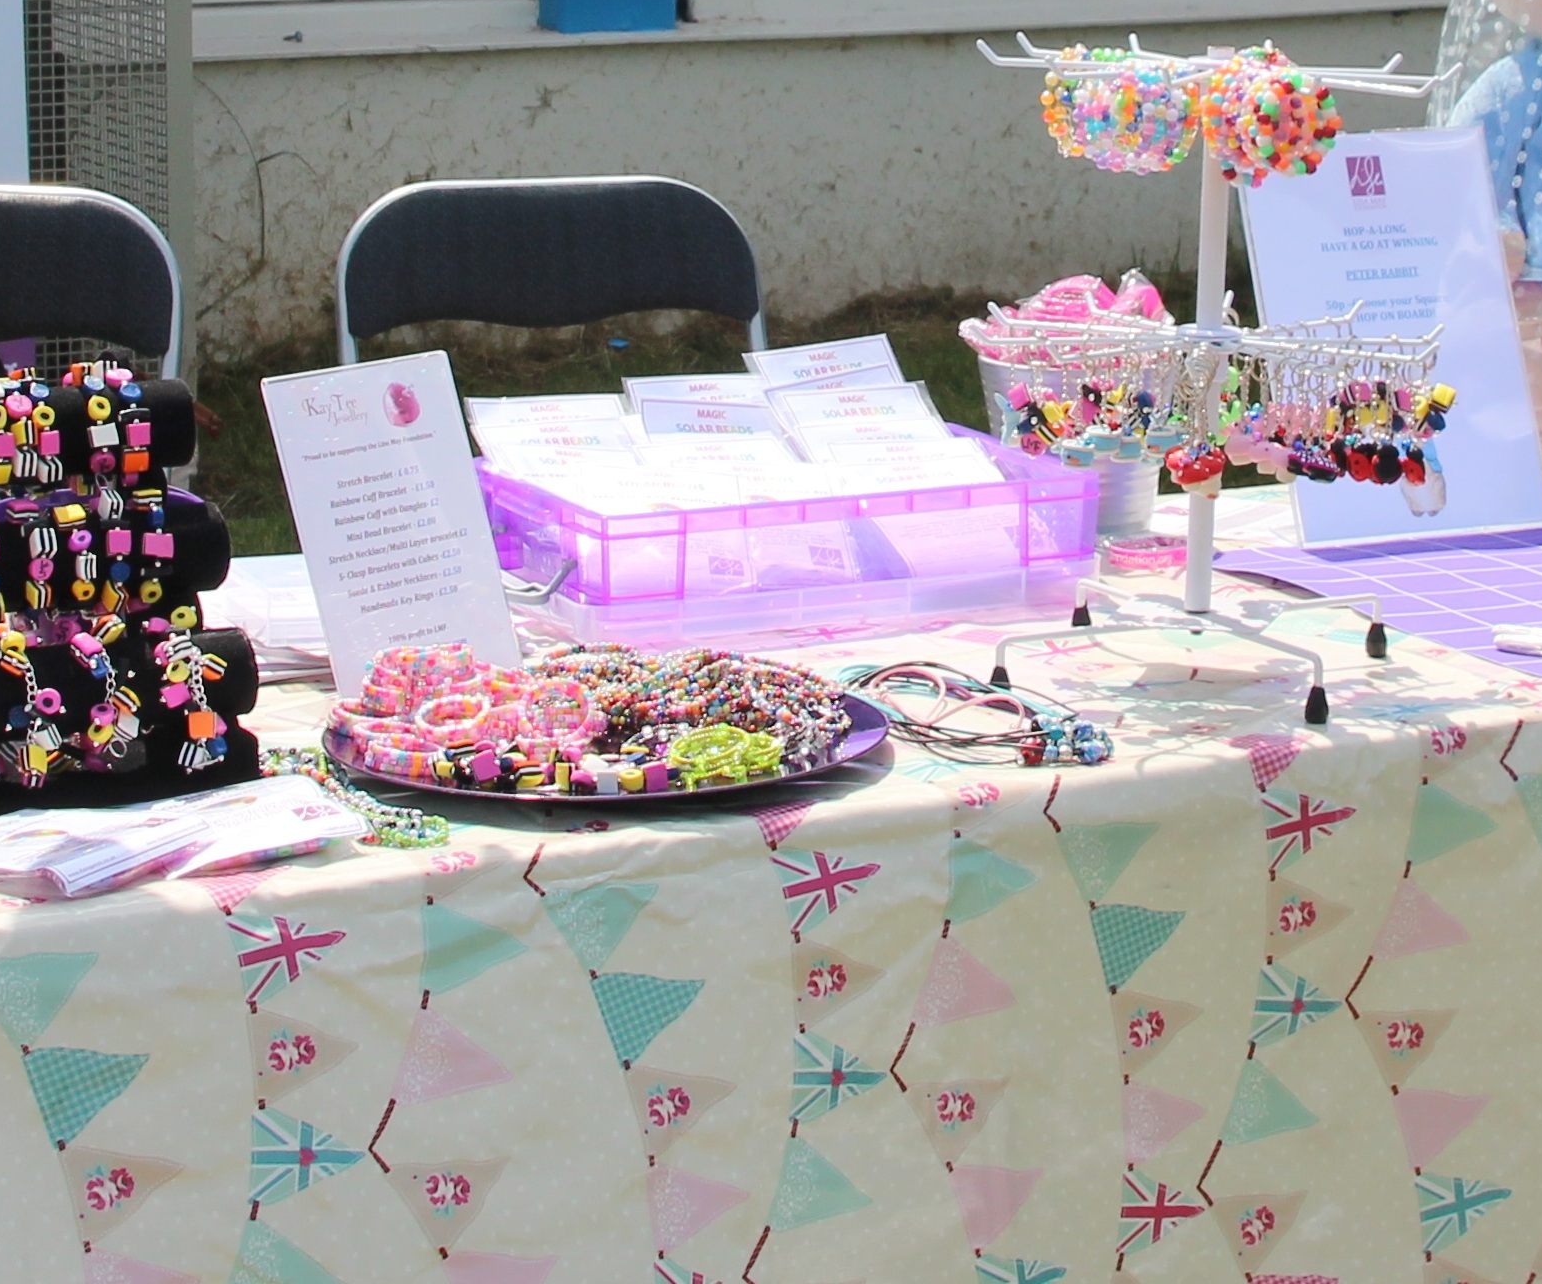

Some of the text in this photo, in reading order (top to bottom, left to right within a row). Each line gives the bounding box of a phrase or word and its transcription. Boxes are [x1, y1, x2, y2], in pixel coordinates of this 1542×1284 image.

[1343, 224, 1406, 236] HOP-A-LONG
[1320, 236, 1438, 251] HAVE A GO AT WINNING
[1345, 266, 1419, 280] PETER RABBIT
[1325, 300, 1344, 311] 50p
[1389, 296, 1412, 307] your
[1357, 313, 1378, 323] HOP
[1380, 311, 1393, 321] ON
[808, 351, 837, 361] MAGIC
[793, 366, 828, 379] SOLAR
[689, 383, 720, 392] MAGIC
[838, 394, 867, 403] MAGIC
[530, 404, 562, 413] MAGIC
[697, 409, 727, 419] MAGIC
[823, 405, 896, 418] SOLAR BEADS
[330, 407, 370, 430] Jewellery
[540, 425, 570, 433] MAGIC
[675, 423, 754, 435] SOLAR BEADS
[562, 435, 601, 446] BEADS
[886, 445, 915, 453] MAGIC
[336, 476, 363, 489] Stretch
[362, 470, 393, 483] Bracelet
[329, 495, 361, 509] Rainbow
[361, 491, 378, 503] Cuff
[377, 486, 407, 499] Bracelet
[333, 512, 366, 526] Rainbow
[366, 509, 381, 520] Cuff
[381, 506, 397, 516] with
[346, 532, 362, 541] Mini
[363, 527, 382, 538] Bead
[327, 551, 354, 564] Stretch
[408, 537, 429, 549] Layer
[346, 568, 367, 580] Clasp
[366, 561, 400, 574] Bracelets
[401, 557, 417, 567] with
[417, 552, 438, 563] Cubes
[369, 584, 375, 592] &
[376, 578, 404, 591] Rubber
[402, 571, 438, 585] Necklaces
[359, 598, 398, 614] Handmade
[399, 595, 413, 605] Key
[413, 590, 434, 603] Rings
